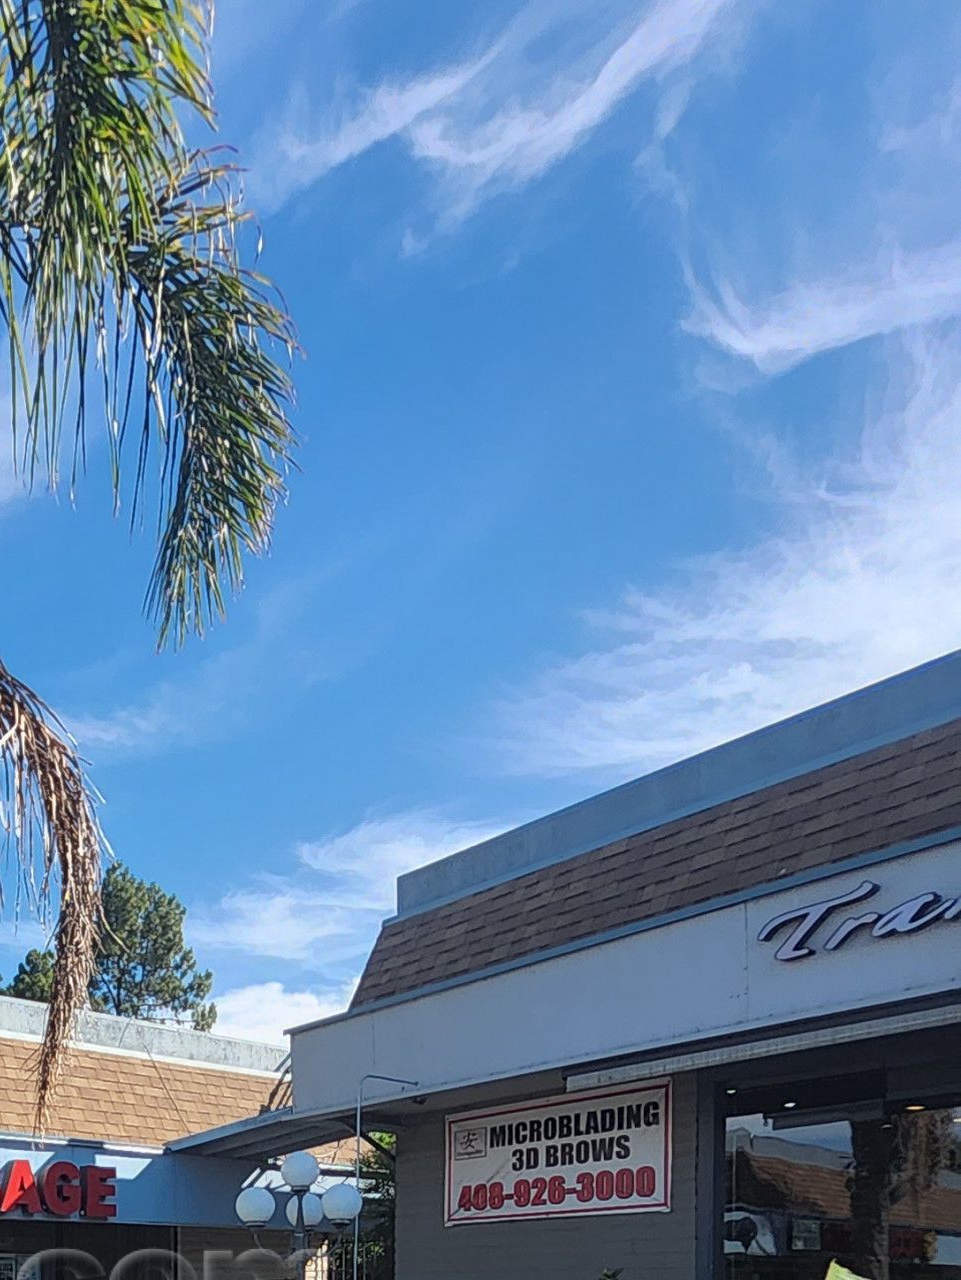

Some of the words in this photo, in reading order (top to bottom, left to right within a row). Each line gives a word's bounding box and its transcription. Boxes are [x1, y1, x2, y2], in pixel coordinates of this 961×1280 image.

[489, 1101, 660, 1149] MICROBLADING
[511, 1147, 539, 1172] 3D
[545, 1134, 631, 1168] BROWS
[457, 1165, 656, 1212] 408-926-3000
